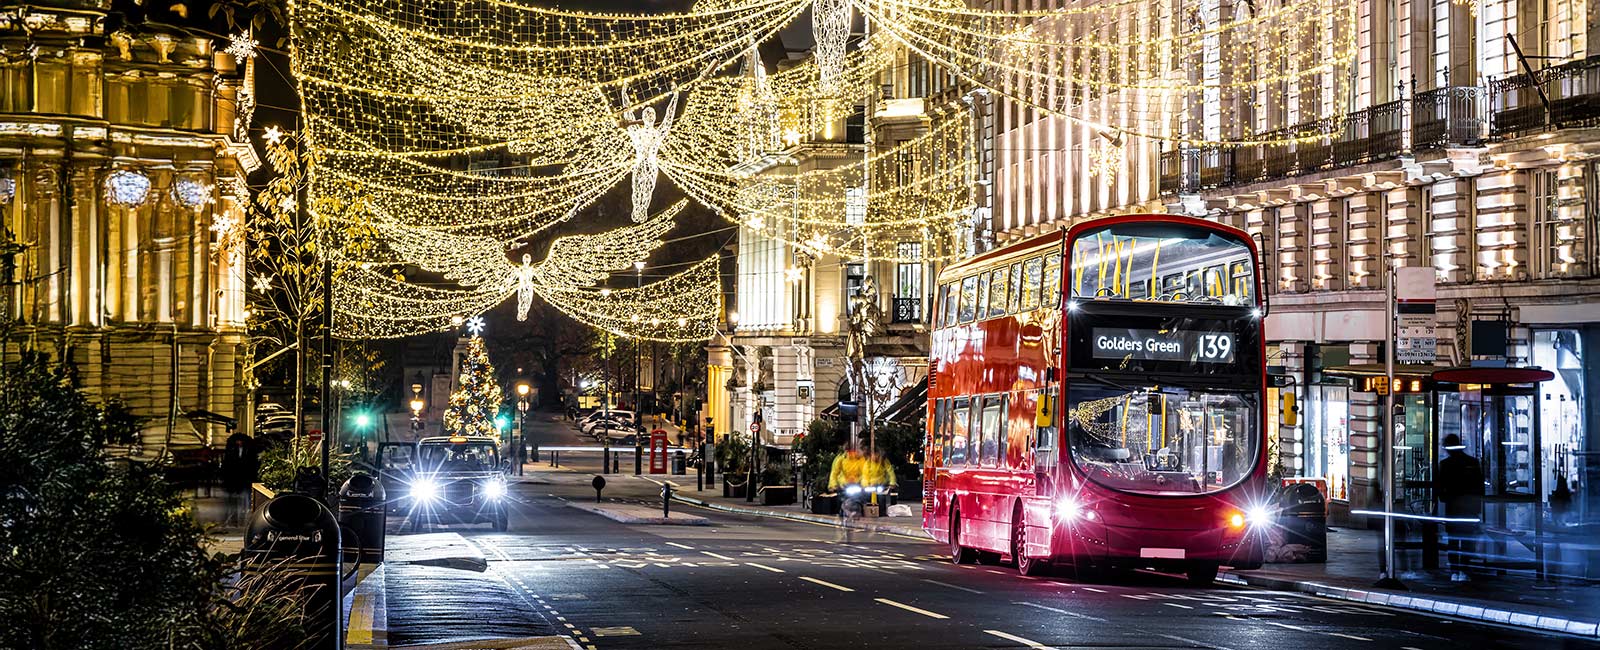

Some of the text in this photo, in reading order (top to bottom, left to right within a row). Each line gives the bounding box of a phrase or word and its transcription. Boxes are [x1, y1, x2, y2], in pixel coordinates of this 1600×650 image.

[1098, 336, 1180, 352] Golders Green
[1199, 335, 1231, 358] 139
